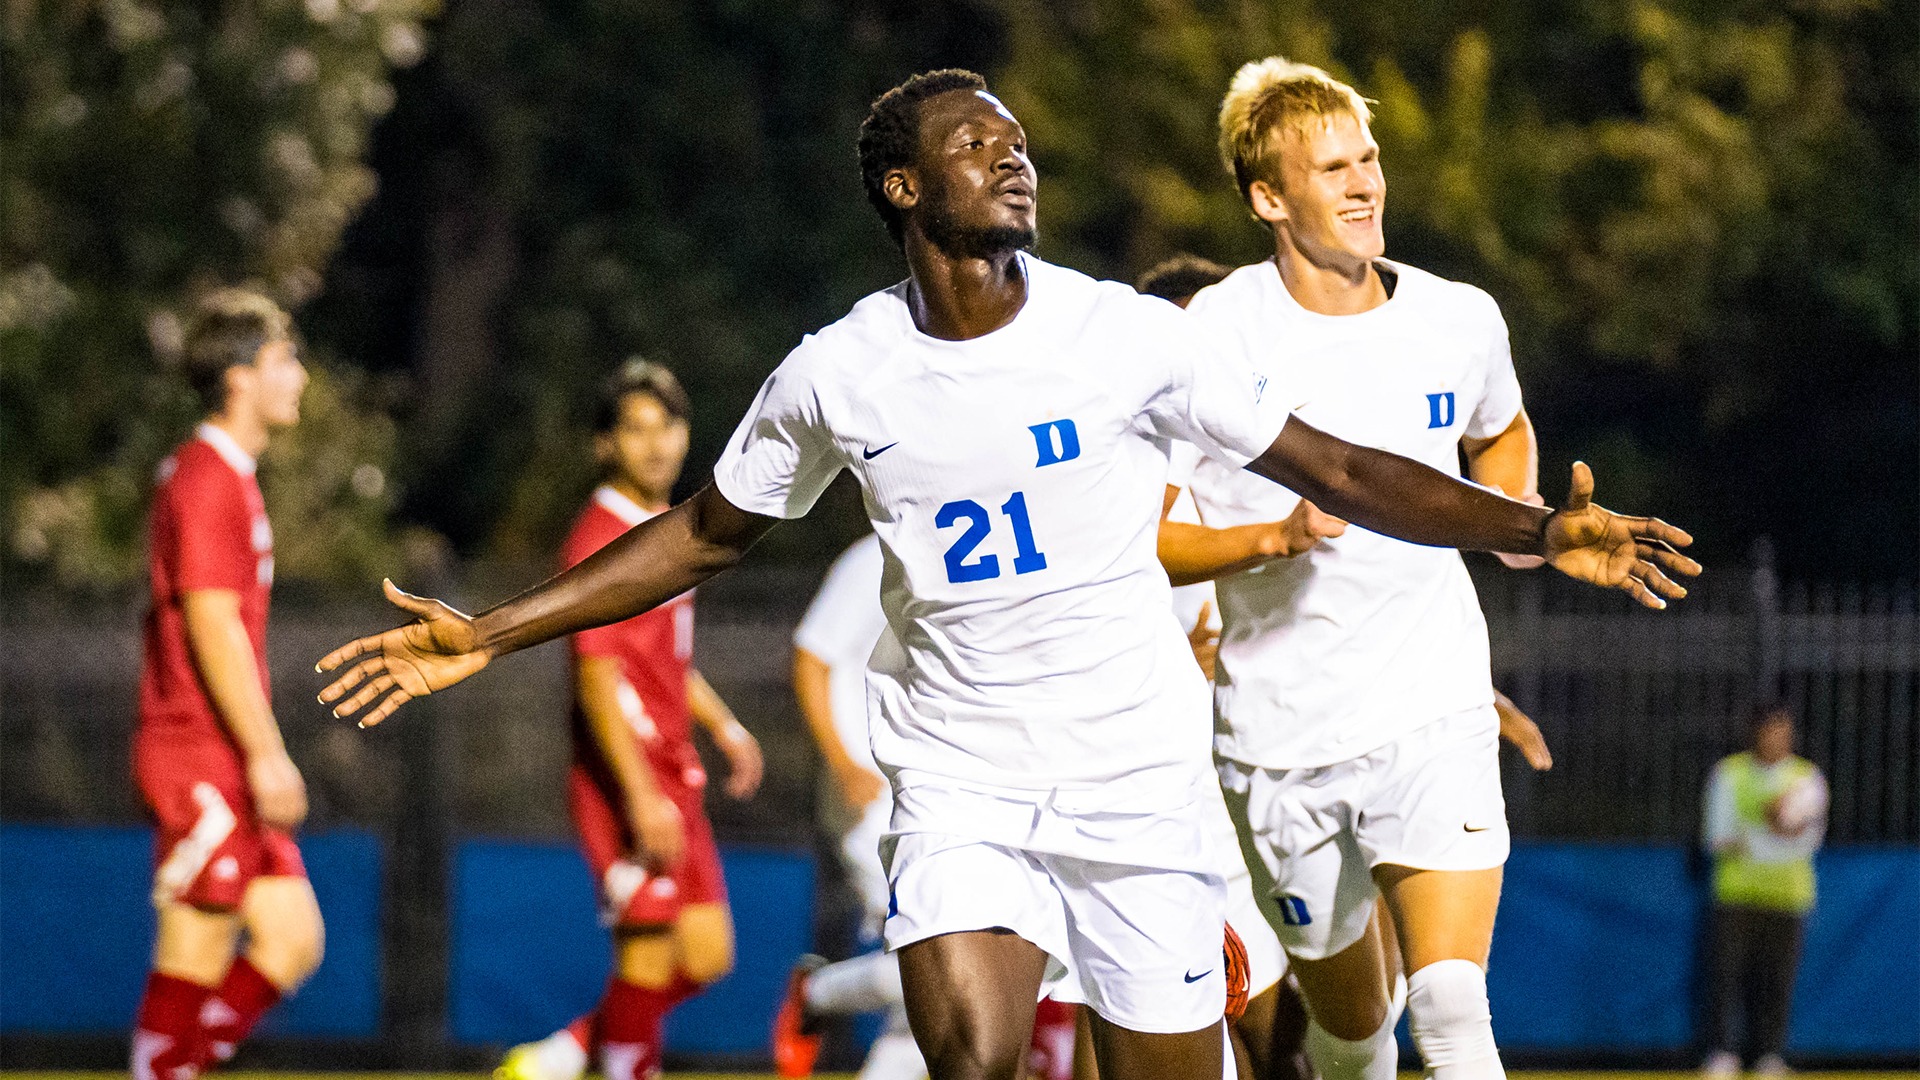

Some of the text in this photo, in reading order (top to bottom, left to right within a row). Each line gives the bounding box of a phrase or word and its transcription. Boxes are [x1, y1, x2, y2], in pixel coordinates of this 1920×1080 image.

[1425, 392, 1455, 429] D
[1027, 418, 1081, 468] D
[934, 491, 1048, 584] 21
[1275, 895, 1312, 925] D
